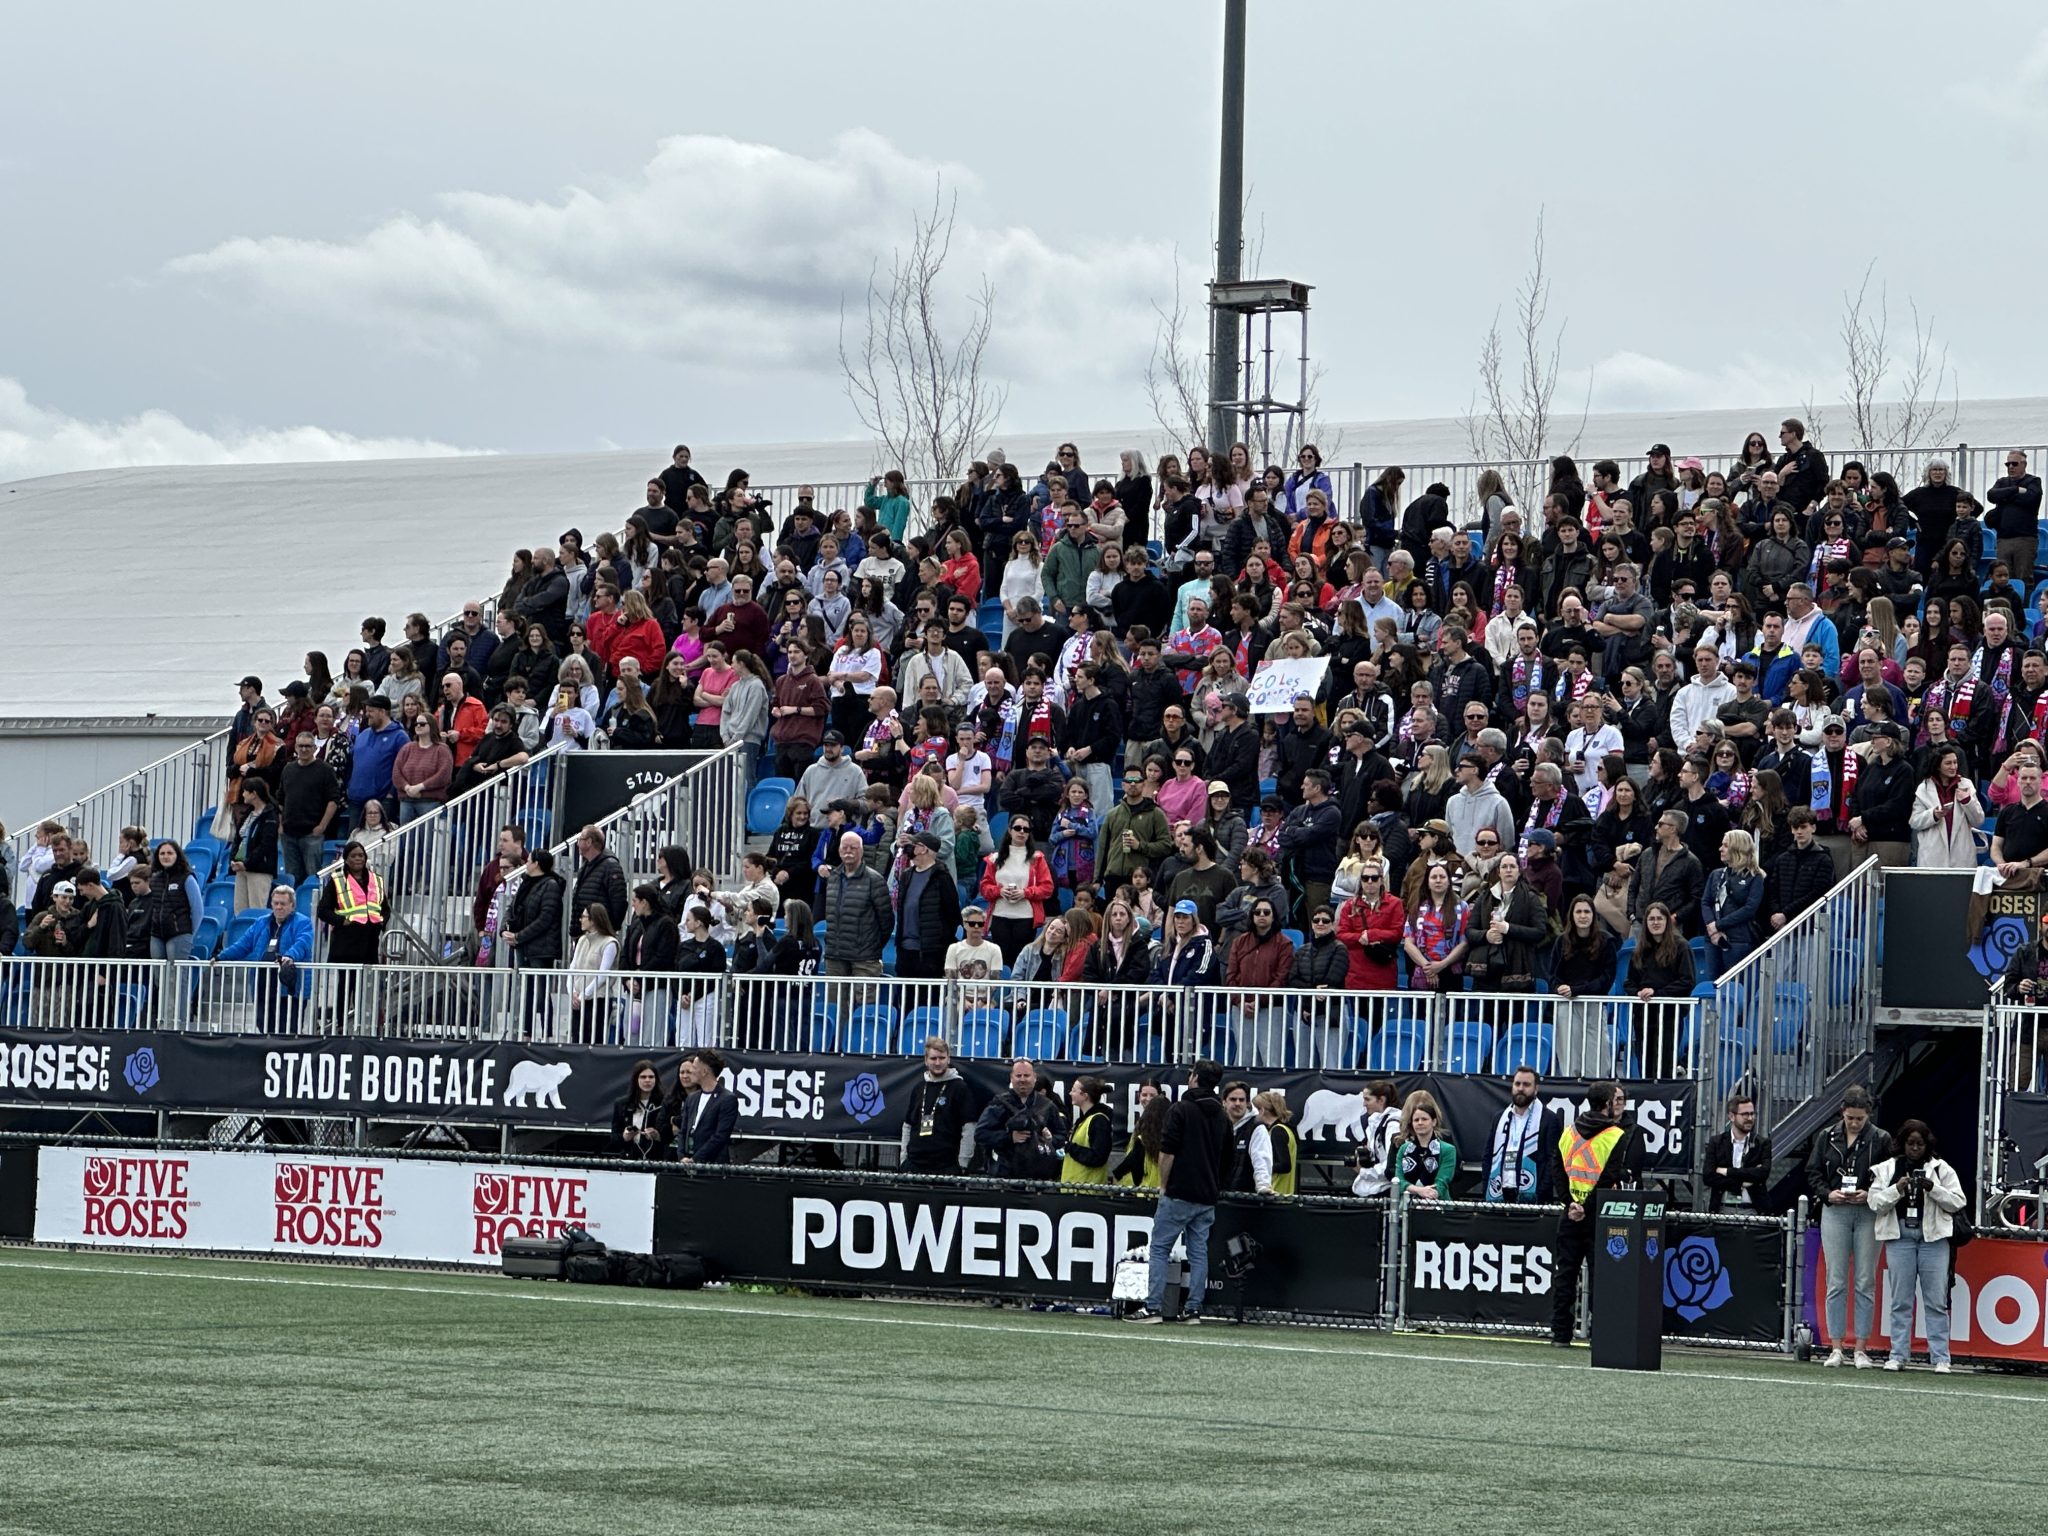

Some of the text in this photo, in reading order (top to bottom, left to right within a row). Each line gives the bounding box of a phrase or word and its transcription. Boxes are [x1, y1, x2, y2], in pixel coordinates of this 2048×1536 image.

[1989, 895, 2035, 914] OSES
[264, 1051, 496, 1106] STADE BORÉALE
[117, 1158, 189, 1199] FIVE
[309, 1164, 384, 1207] FIVE
[509, 1175, 588, 1219] FIVE
[82, 1197, 188, 1240] ROSES
[274, 1204, 383, 1248] ROSES
[1414, 1240, 1553, 1295] ROSES
